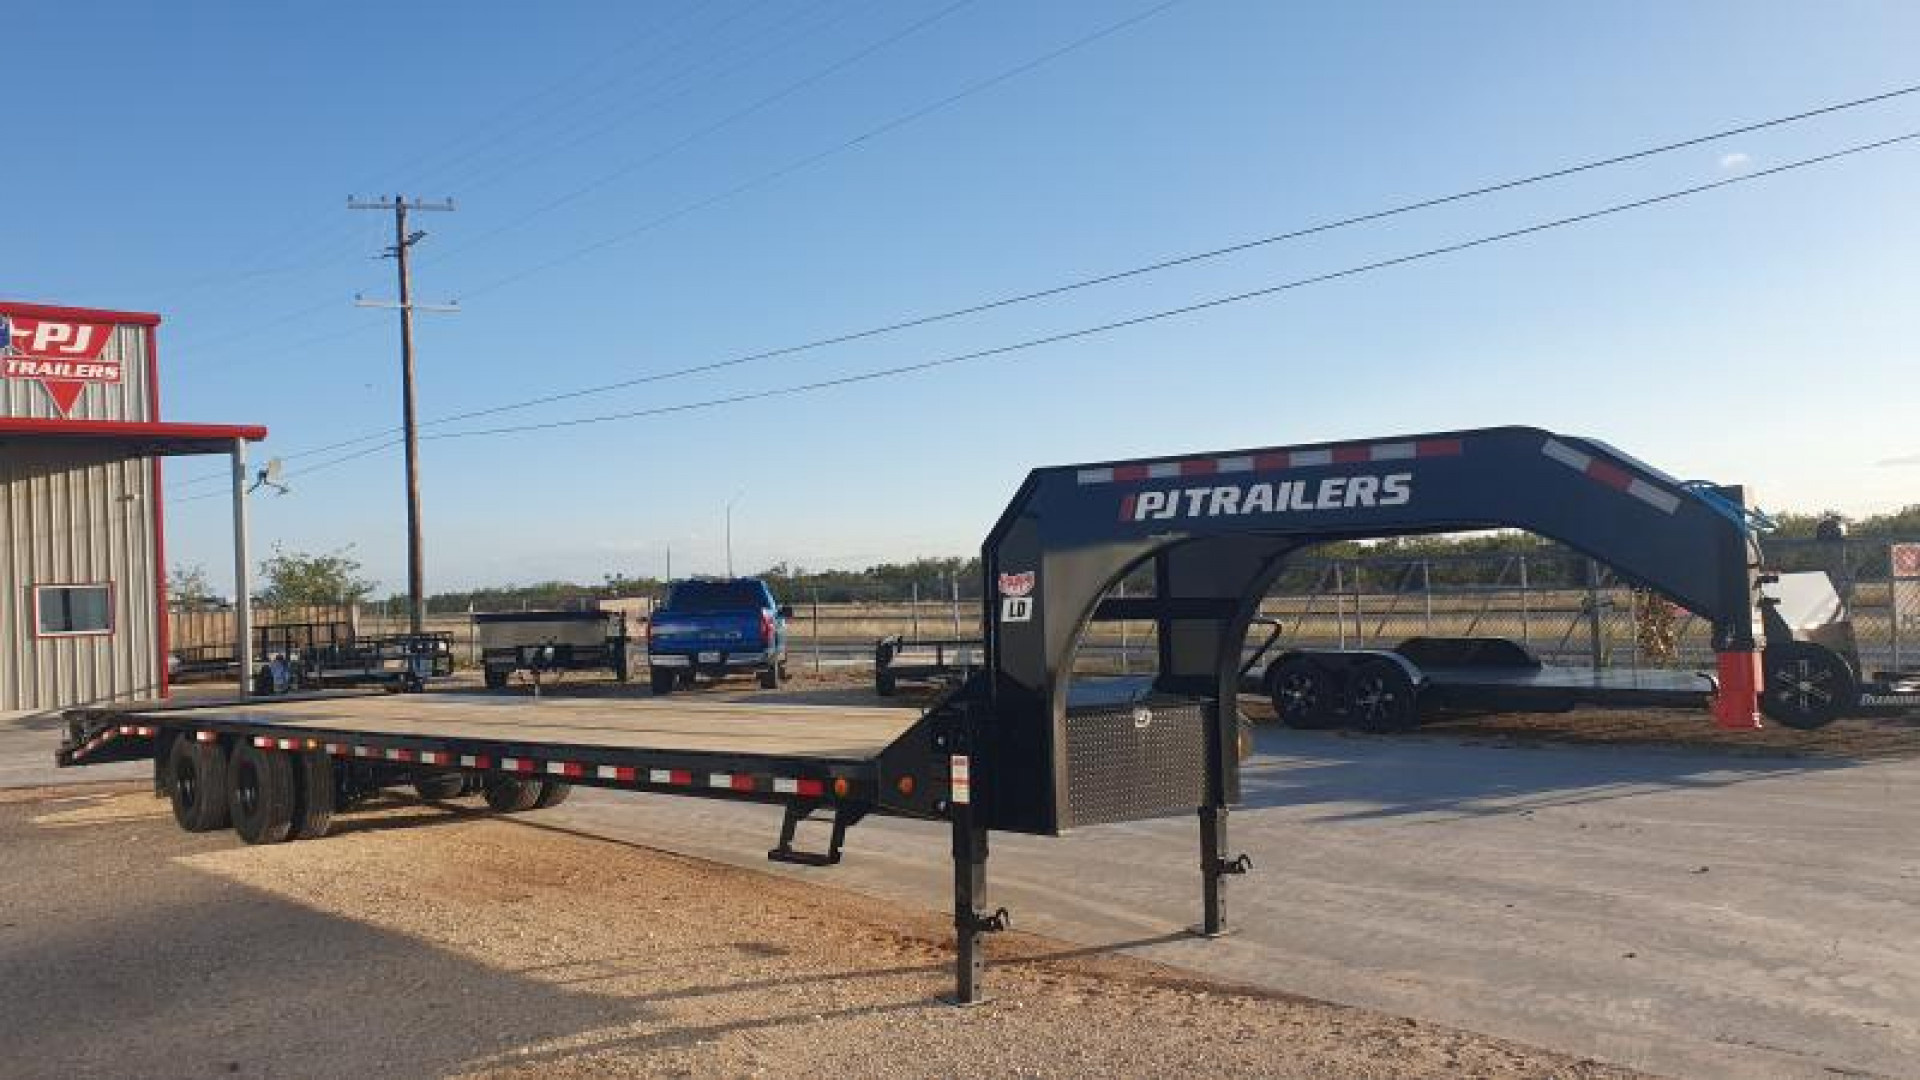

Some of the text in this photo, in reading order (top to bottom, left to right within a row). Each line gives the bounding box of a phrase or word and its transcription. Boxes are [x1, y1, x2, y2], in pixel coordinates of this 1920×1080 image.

[33, 322, 92, 352] PJ
[7, 360, 120, 378] TRAILERS
[1134, 472, 1412, 521] PJ TRAILERS
[1009, 601, 1026, 618] LD
